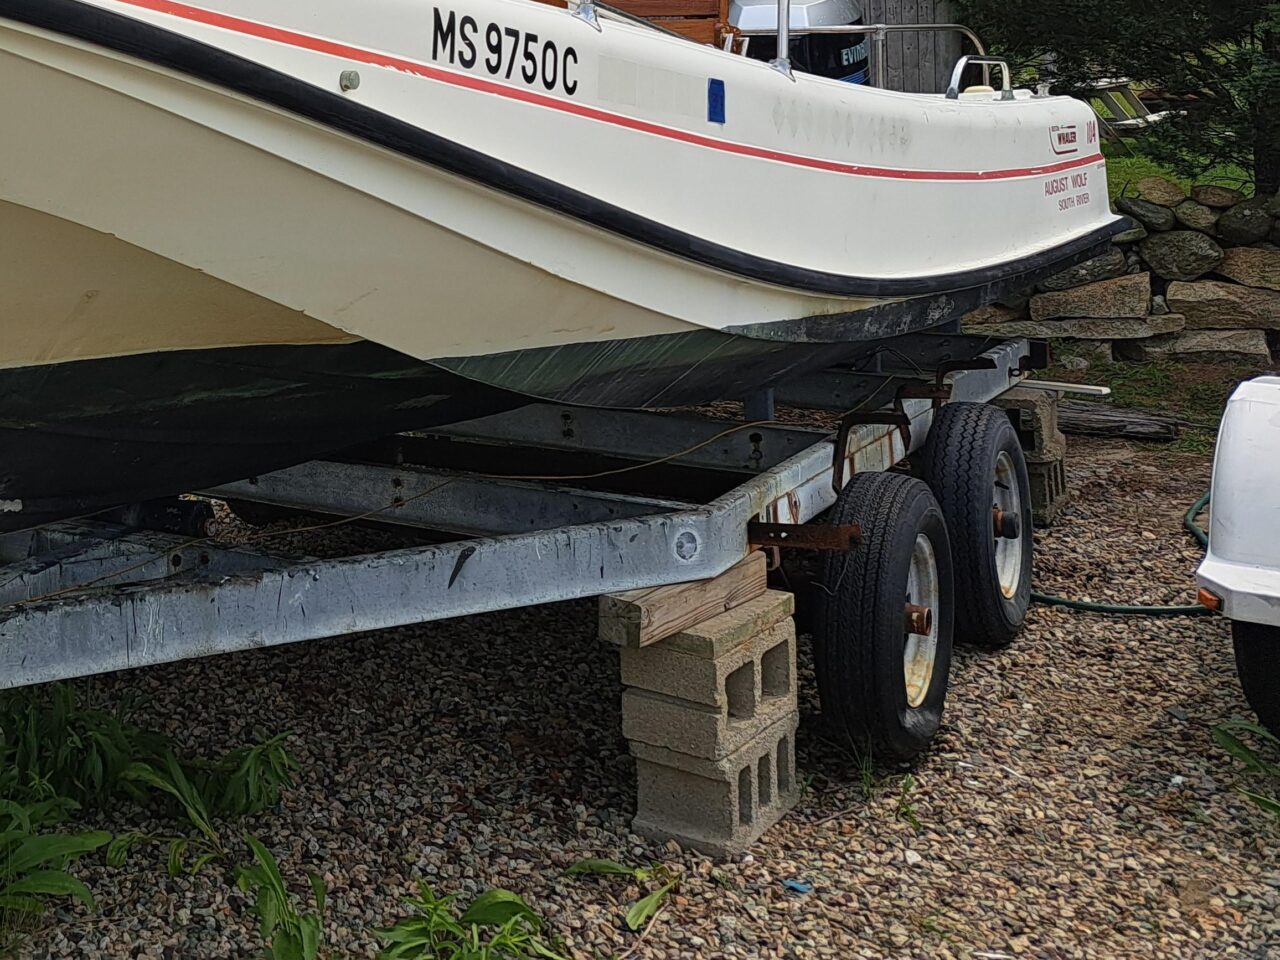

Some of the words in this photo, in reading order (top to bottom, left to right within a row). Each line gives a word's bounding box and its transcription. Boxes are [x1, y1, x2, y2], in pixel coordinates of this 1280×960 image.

[432, 6, 478, 69] MS
[485, 22, 578, 96] 9750C
[1058, 132, 1076, 145] WHALER
[1045, 177, 1068, 196] AUGUST
[1071, 173, 1087, 188] WOLF
[1058, 197, 1075, 211] SOUTH
[1076, 193, 1089, 205] RIVER
